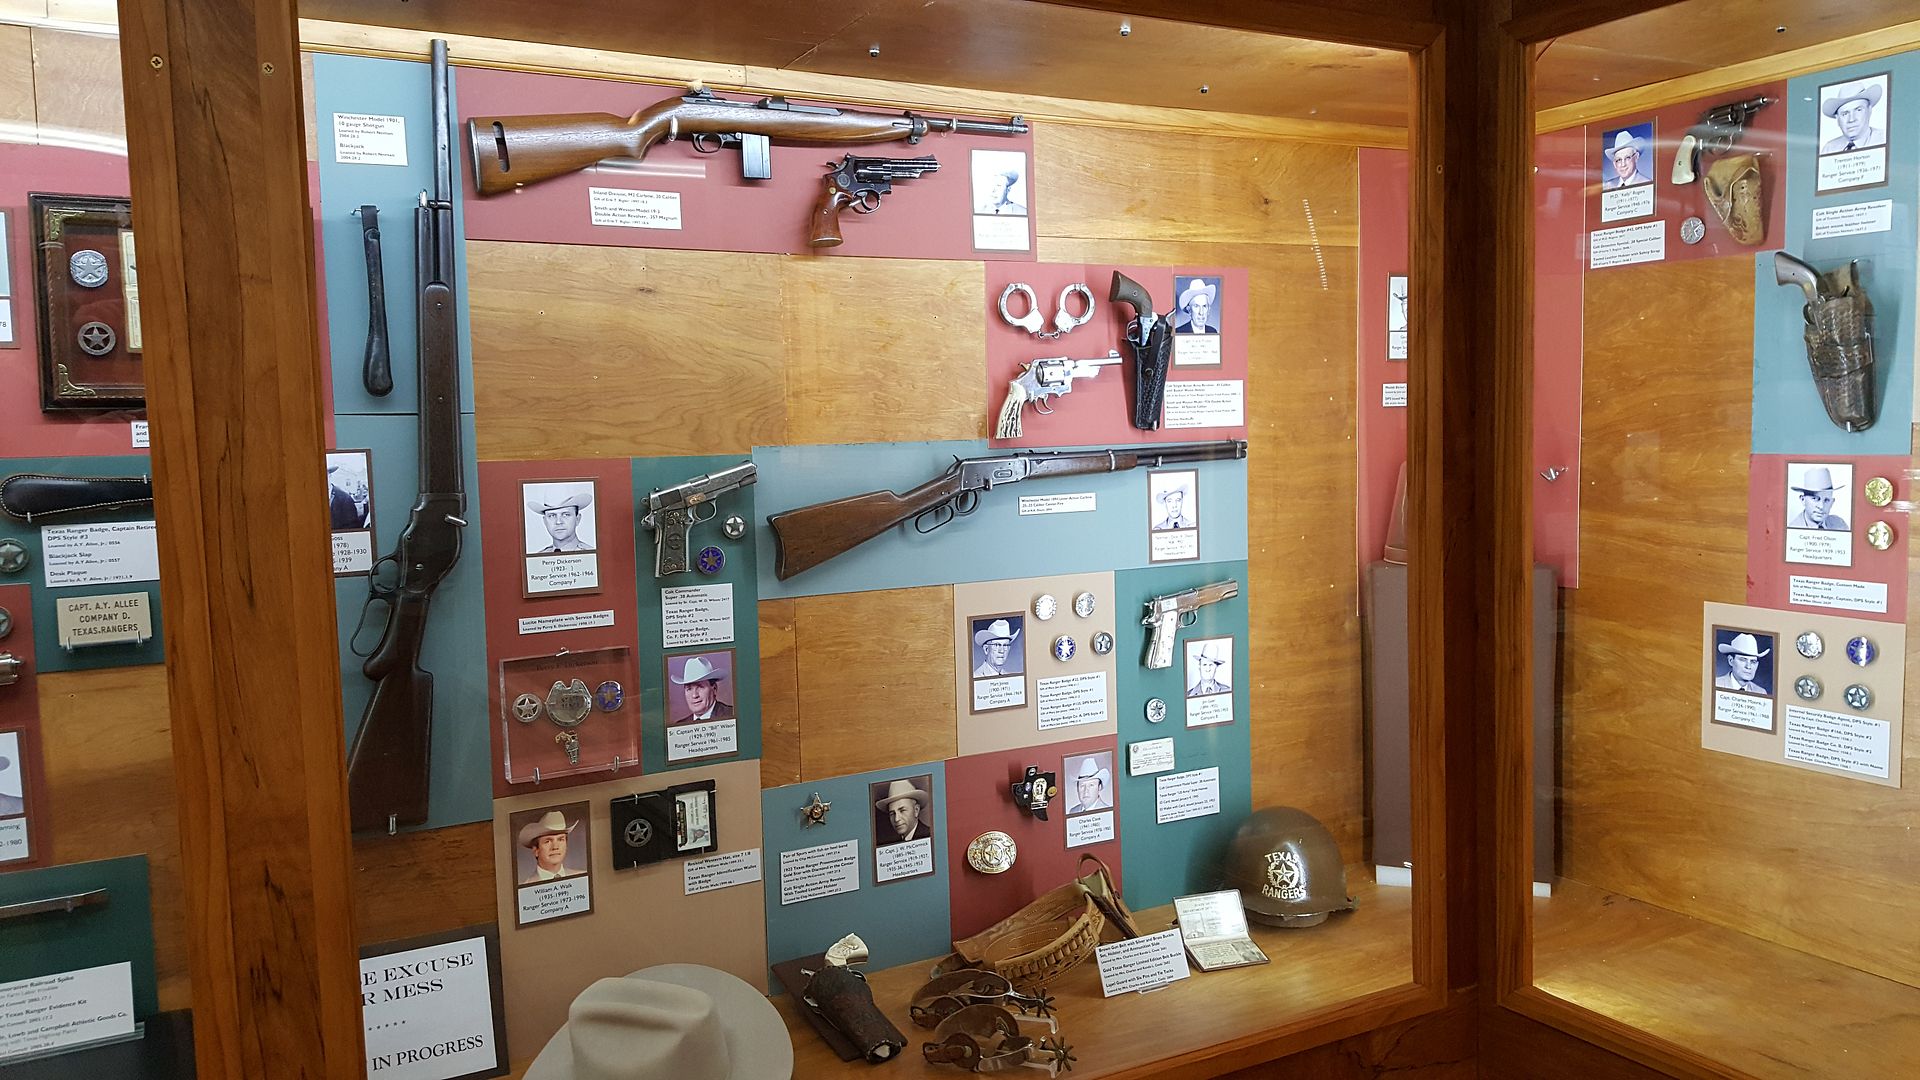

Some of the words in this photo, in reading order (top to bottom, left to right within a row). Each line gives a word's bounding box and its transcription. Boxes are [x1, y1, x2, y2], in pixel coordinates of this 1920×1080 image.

[68, 603, 92, 612] CAPT.
[114, 599, 139, 609] ALLEE
[79, 613, 118, 623] COMPANY
[1265, 851, 1299, 864] TEXAS
[1261, 884, 1307, 900] RANGERS
[540, 906, 564, 915] Company
[384, 952, 474, 982] EXCUSE
[384, 978, 444, 1003] MESS
[372, 1055, 391, 1071] IN
[397, 1034, 483, 1066] PROGRESS
